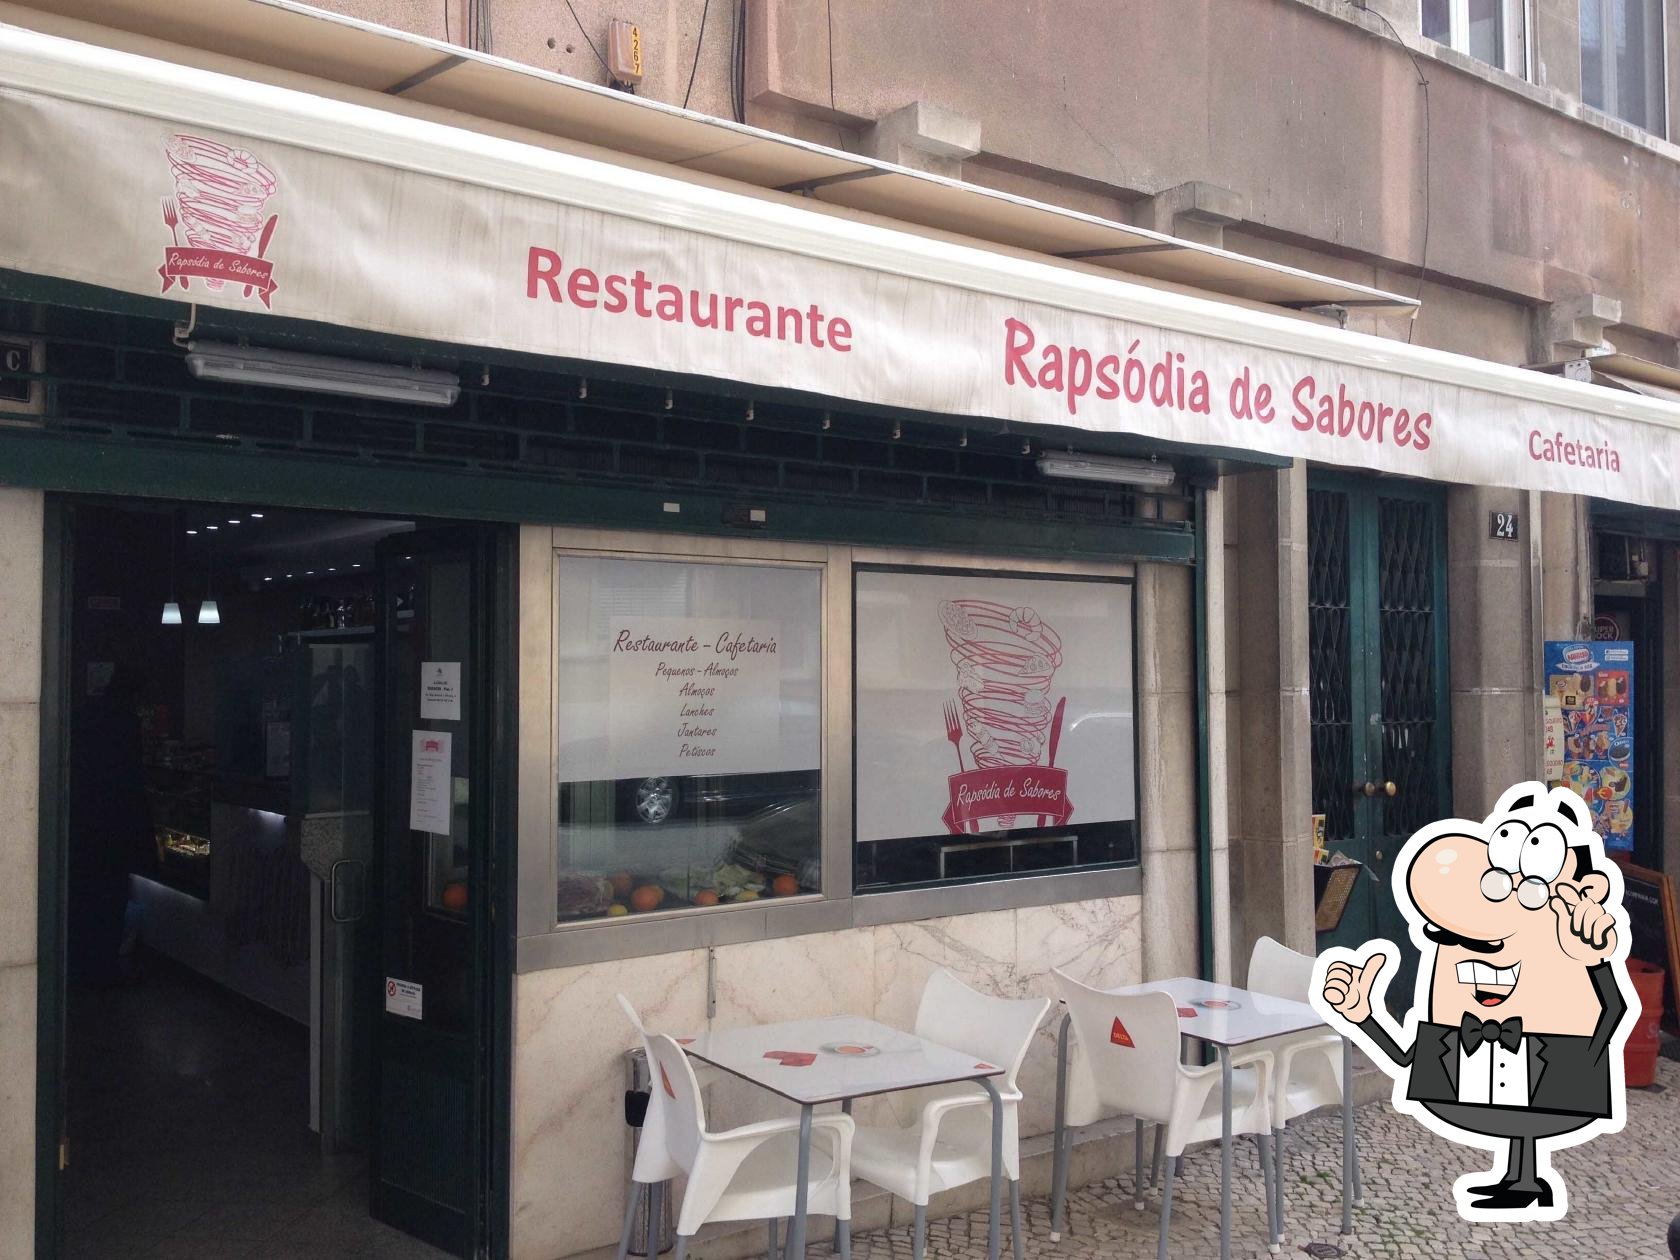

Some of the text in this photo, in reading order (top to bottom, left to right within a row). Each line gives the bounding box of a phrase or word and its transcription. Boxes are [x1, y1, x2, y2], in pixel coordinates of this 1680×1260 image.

[168, 252, 269, 279] Rapsódia de Sabores
[526, 246, 852, 352] Restaurante
[1004, 317, 1433, 451] Rapsódia de Sabores
[1528, 429, 1621, 473] Cafetaria
[1496, 513, 1514, 538] 24
[613, 629, 699, 653] Restaurante
[715, 631, 777, 661] Cafetaria
[679, 682, 715, 698] Almoços
[680, 703, 715, 717] Lanches
[678, 722, 717, 737] Jantares
[679, 743, 716, 757] Petiscos
[957, 777, 1061, 810] Rapsódia de Sabores
